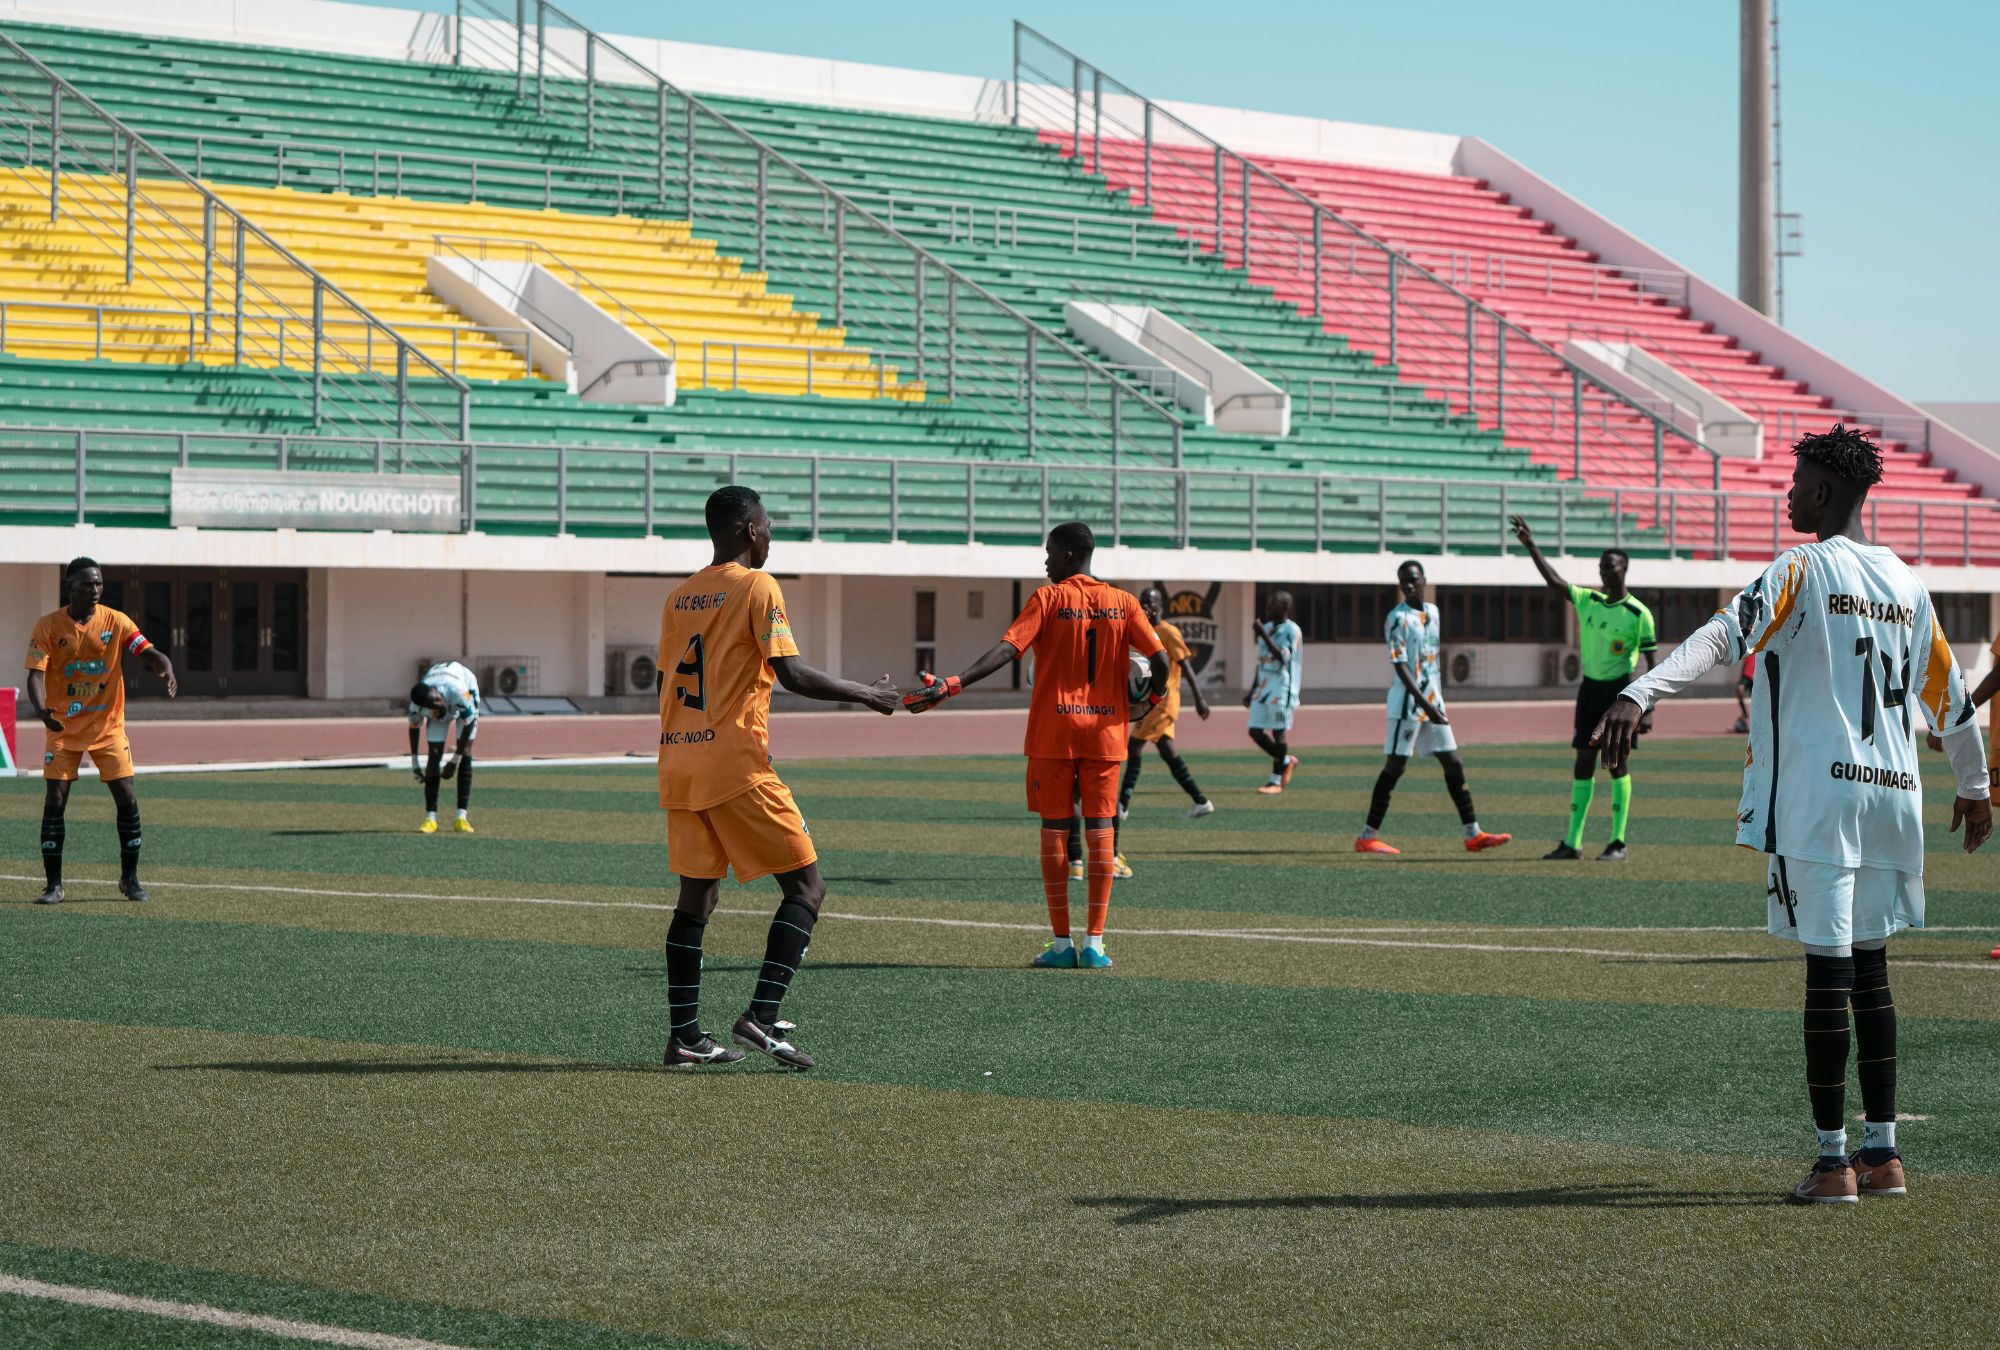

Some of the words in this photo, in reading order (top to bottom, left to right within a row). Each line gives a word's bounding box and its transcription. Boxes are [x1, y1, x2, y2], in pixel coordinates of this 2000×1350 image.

[221, 491, 304, 514] Olympique
[320, 491, 457, 515] NOUAKCHOTT
[676, 633, 706, 711] 9
[1086, 627, 1097, 687] 1
[1855, 636, 1912, 748] 14
[1830, 760, 1917, 792] GUIDIMAGH
